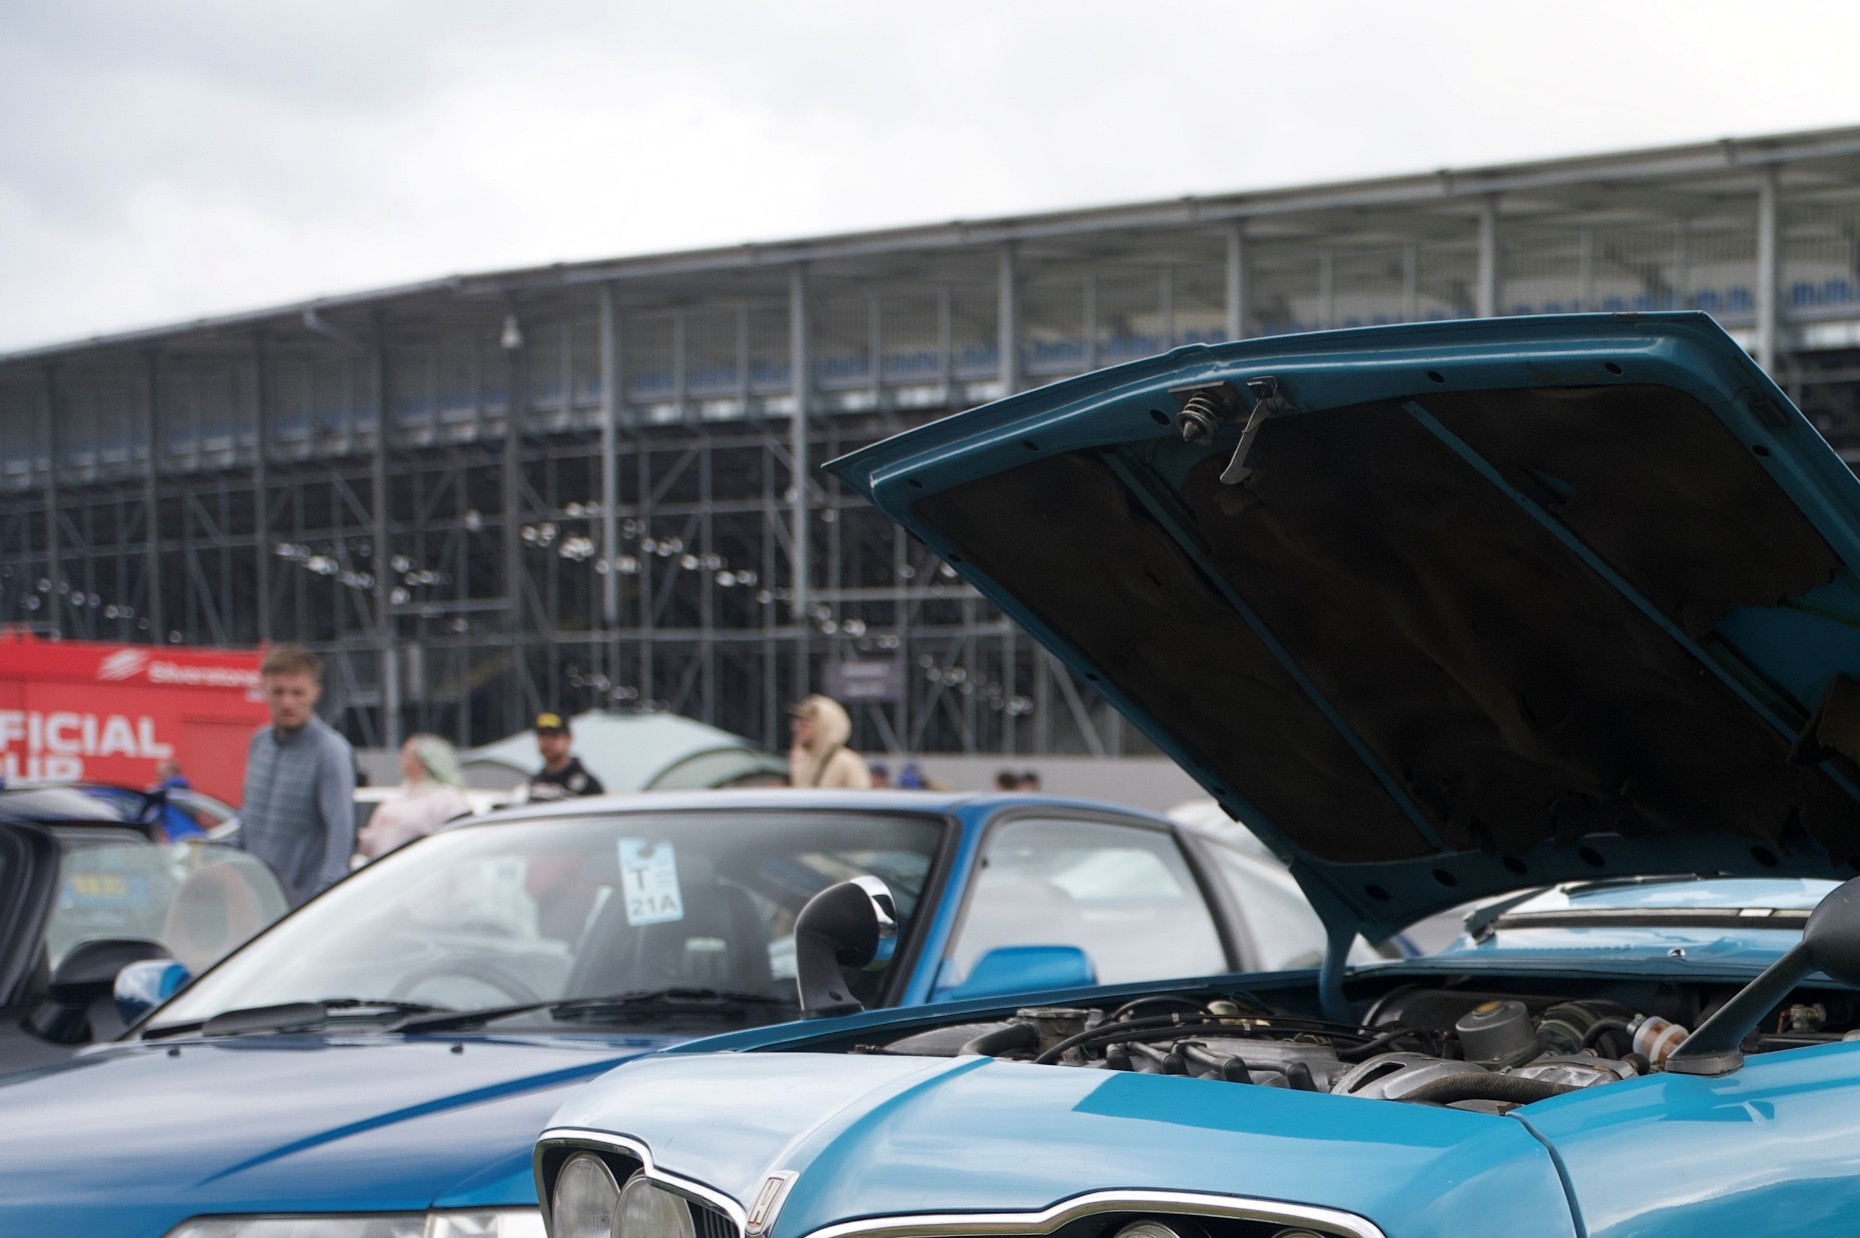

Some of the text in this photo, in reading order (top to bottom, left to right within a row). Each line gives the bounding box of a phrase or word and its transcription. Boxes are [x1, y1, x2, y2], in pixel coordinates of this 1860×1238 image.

[0, 757, 83, 785] UP
[628, 866, 652, 890] T
[632, 895, 677, 916] 21A
